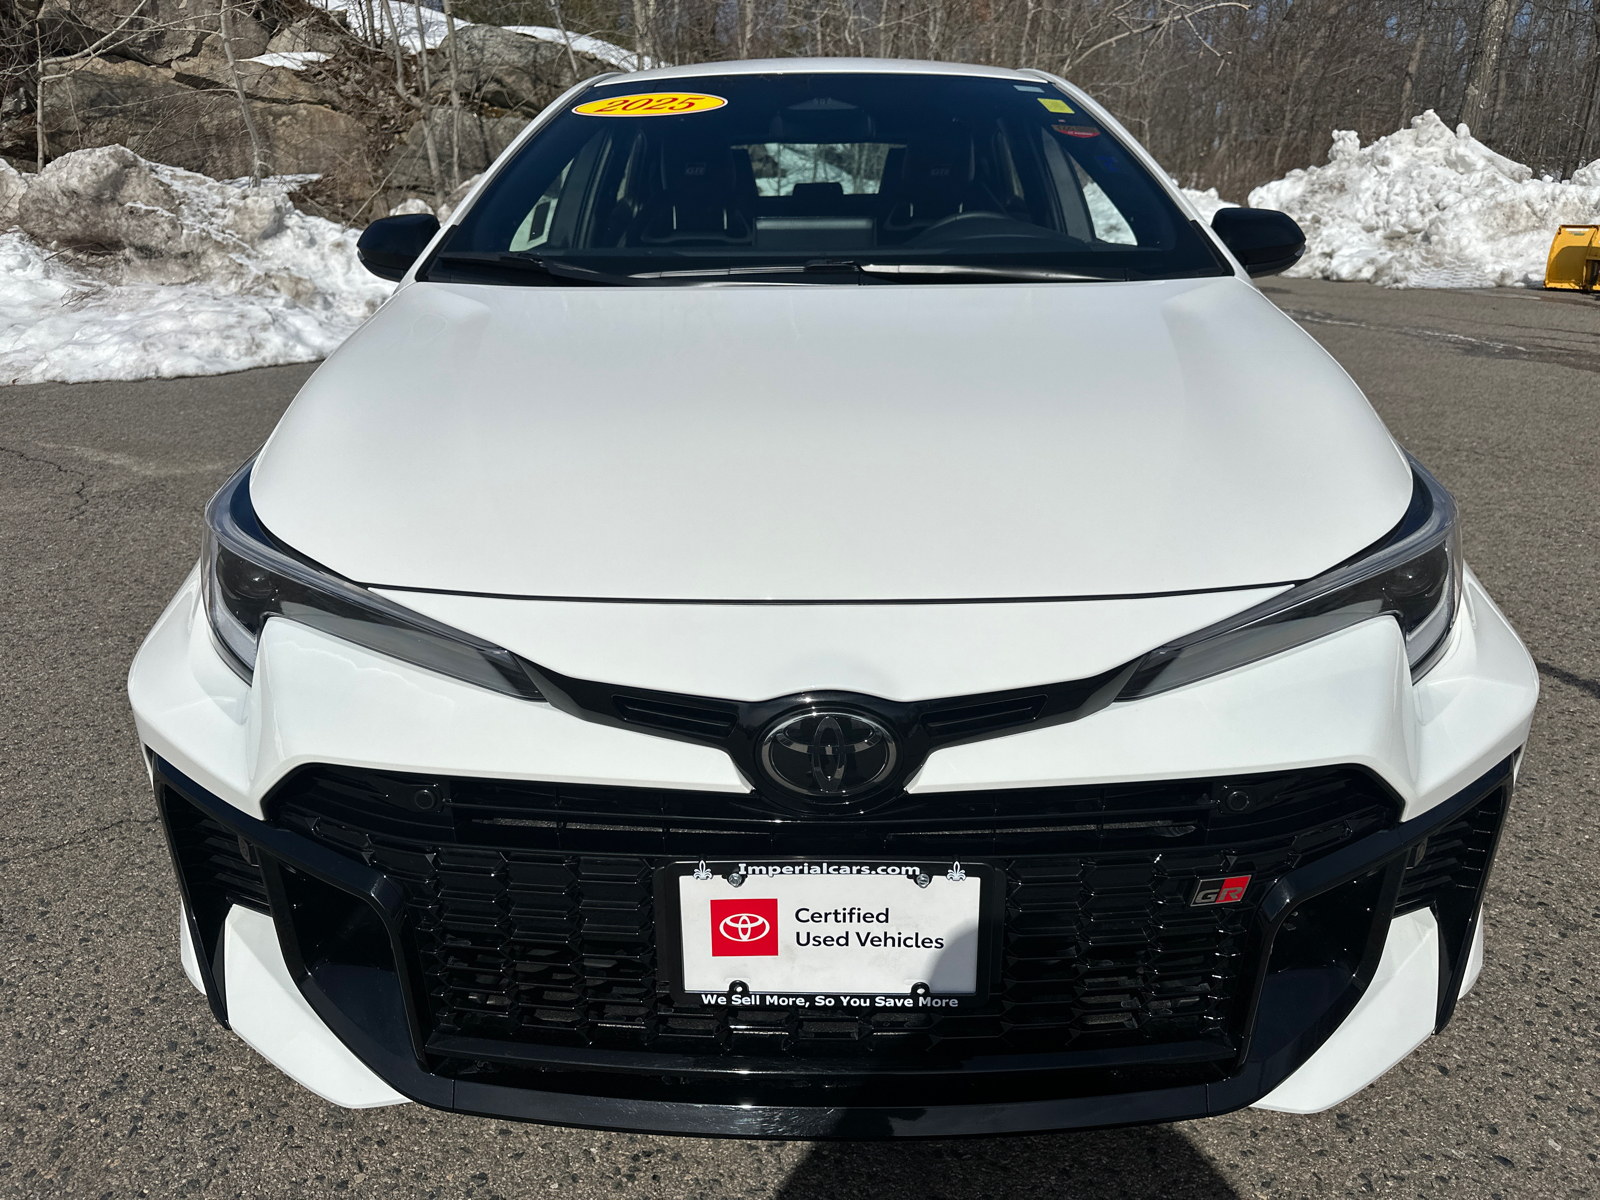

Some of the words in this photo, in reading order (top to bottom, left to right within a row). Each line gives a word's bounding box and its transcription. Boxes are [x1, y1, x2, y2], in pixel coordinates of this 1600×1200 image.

[594, 97, 705, 113] 2025
[738, 863, 920, 878] Imperialcars.com
[1195, 886, 1243, 903] GR
[795, 907, 889, 923] Certified
[795, 931, 849, 947] Used
[856, 931, 944, 949] Vehicles
[701, 994, 727, 1005] We
[731, 994, 760, 1005] Sell
[765, 995, 809, 1007] More,
[814, 996, 835, 1006] So
[840, 996, 870, 1007] You
[875, 996, 914, 1007] Save
[919, 996, 958, 1007] More
